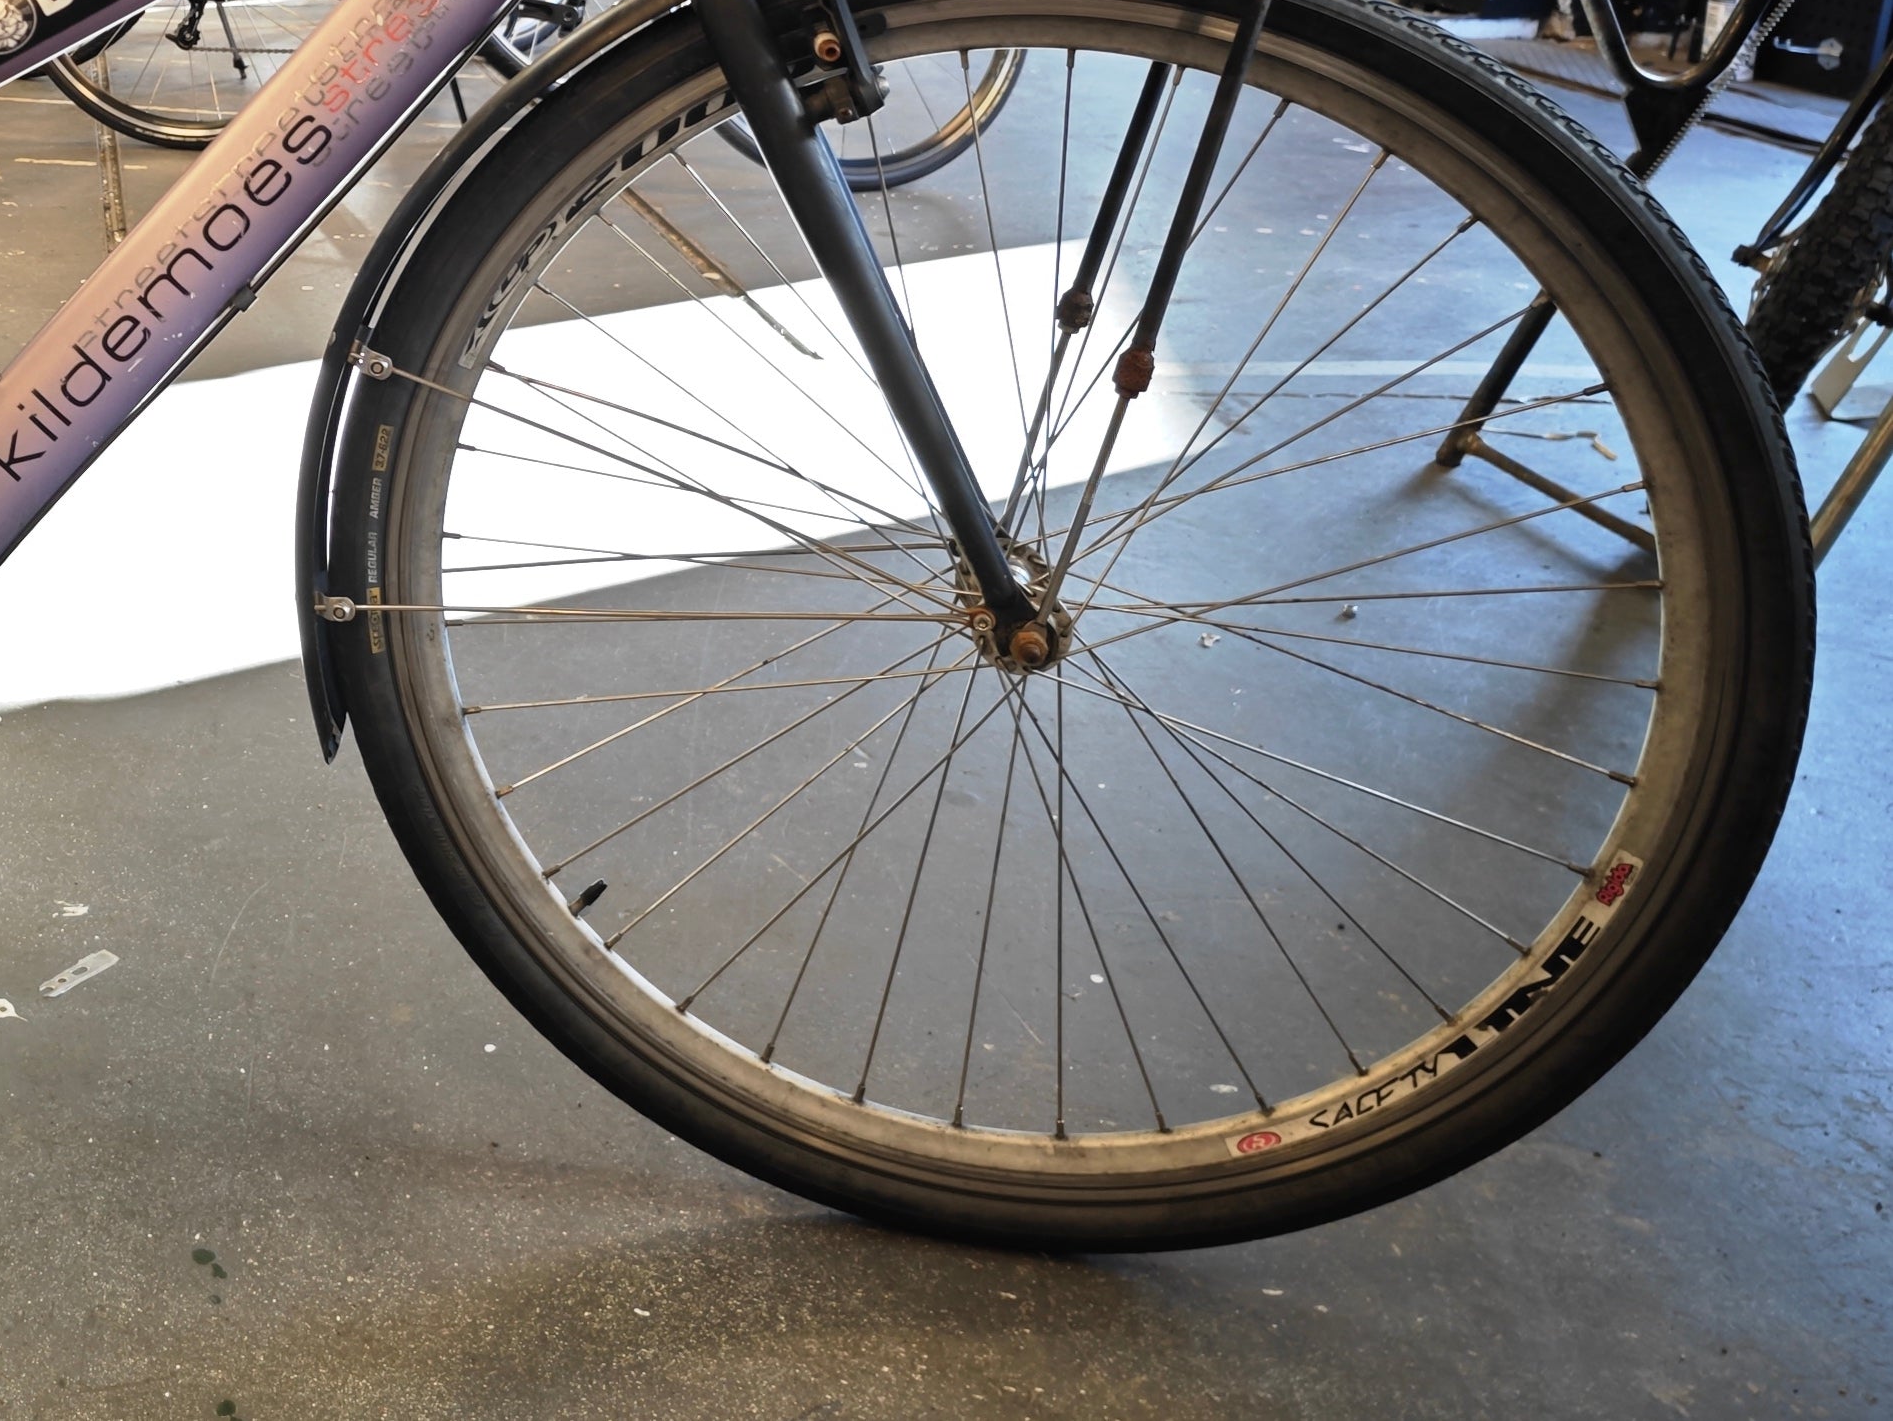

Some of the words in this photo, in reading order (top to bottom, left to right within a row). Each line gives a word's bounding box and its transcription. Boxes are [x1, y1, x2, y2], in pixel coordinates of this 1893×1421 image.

[370, 478, 383, 519] AMBER
[368, 531, 378, 584] REGULAR
[1308, 1051, 1446, 1129] SAFETY
[1444, 915, 1601, 1060] LINE
